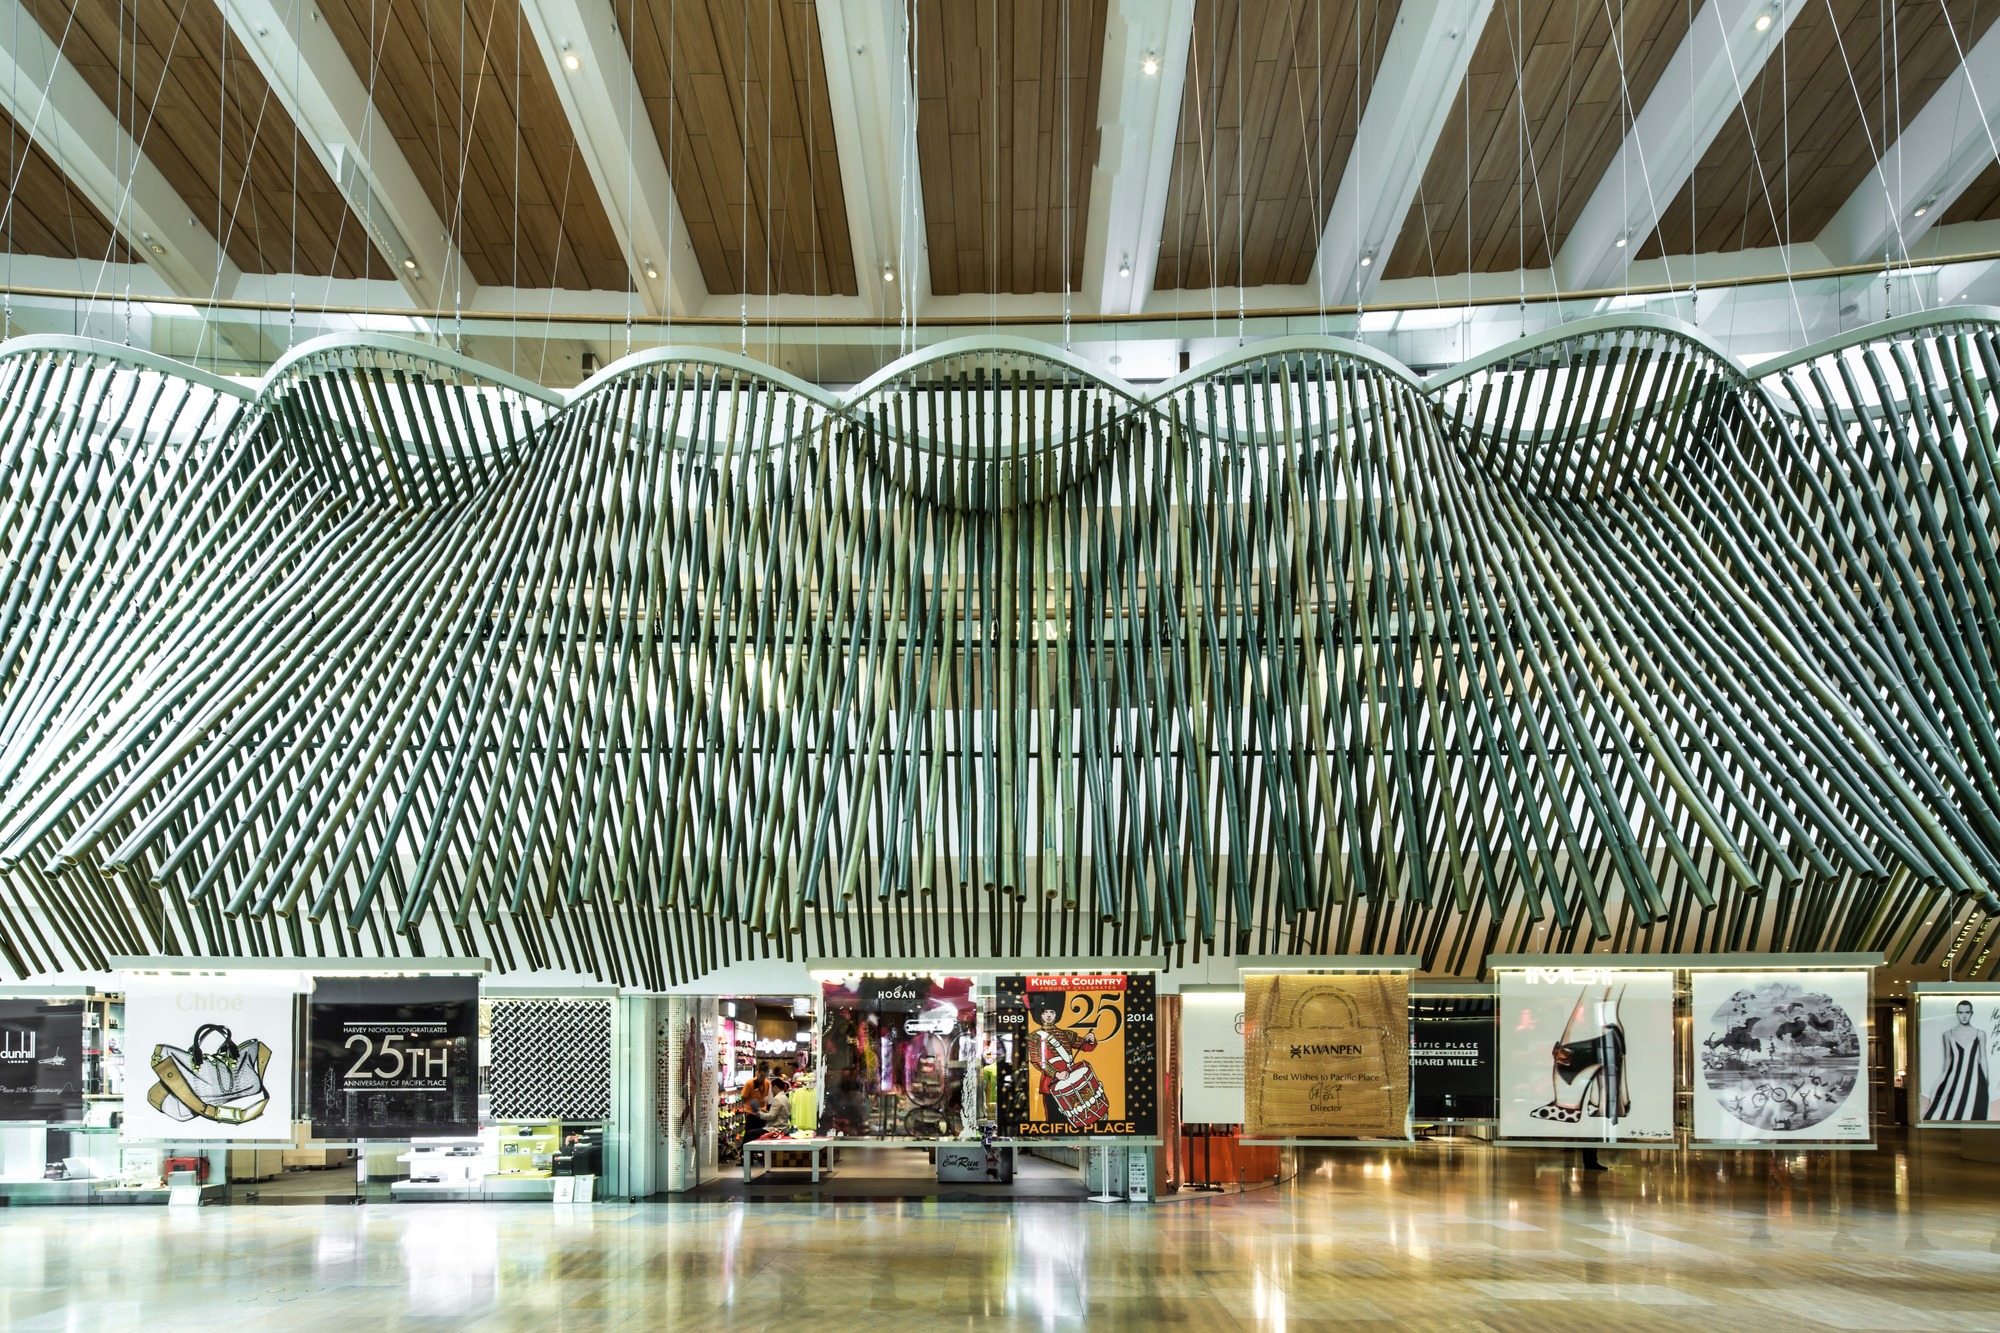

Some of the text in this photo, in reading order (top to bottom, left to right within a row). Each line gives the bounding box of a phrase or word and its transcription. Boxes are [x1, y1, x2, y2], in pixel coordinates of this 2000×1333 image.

[1031, 978, 1122, 986] KING & COUNTRY
[878, 991, 916, 999] HOGAN
[176, 990, 244, 1011] Chloé
[998, 1015, 1025, 1023] 1989
[1067, 992, 1123, 1042] 25
[1126, 1013, 1154, 1022] 2014
[0, 1031, 36, 1059] dunhill
[1303, 1045, 1362, 1055] KWANPEN
[344, 1034, 447, 1078] 25TH
[1447, 1058, 1478, 1067] MILLE
[1272, 1073, 1380, 1082] Best Wishes to Pacific Place
[1310, 1104, 1342, 1112] Director
[1020, 1122, 1136, 1134] PACIFIC PLACE
[957, 1157, 979, 1168] Run
